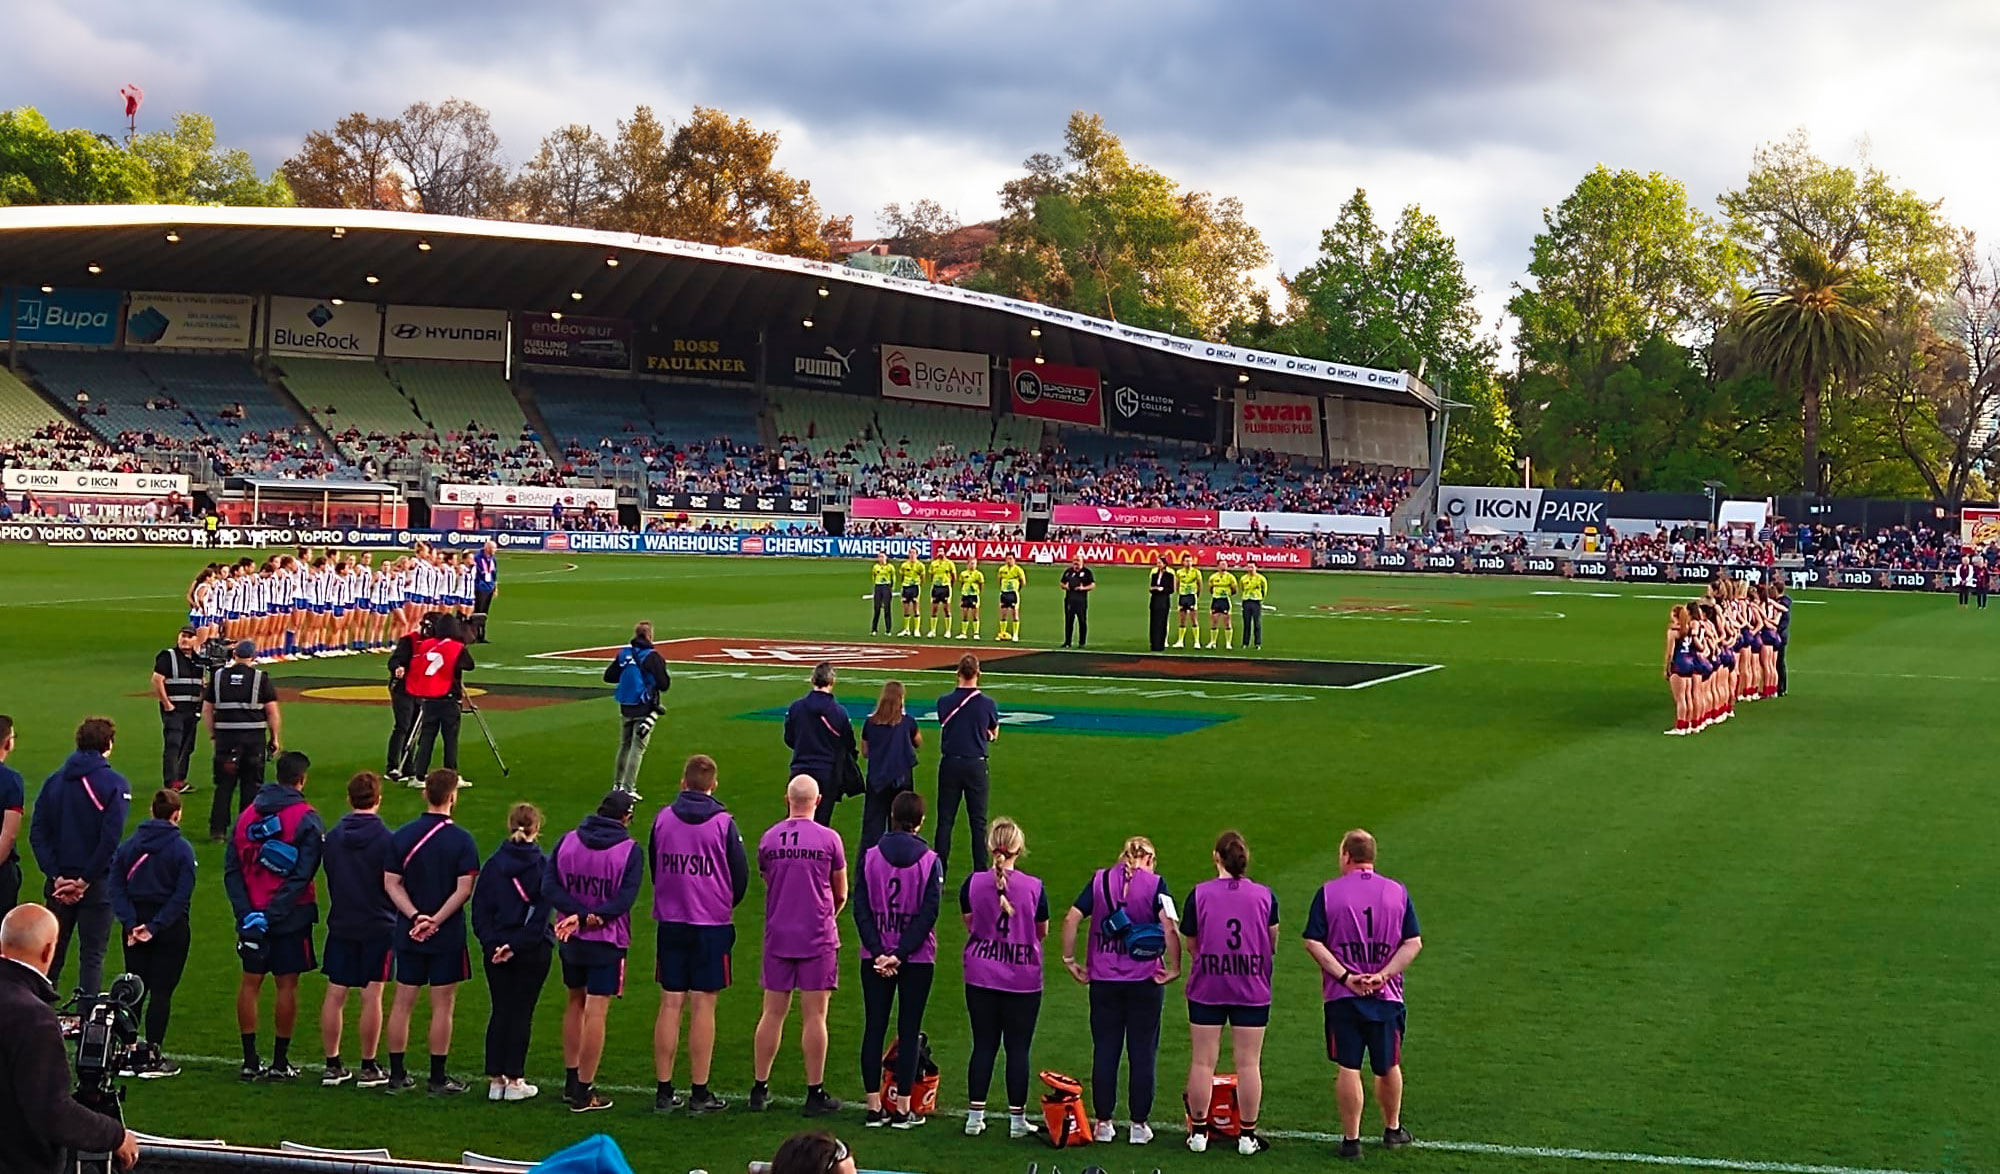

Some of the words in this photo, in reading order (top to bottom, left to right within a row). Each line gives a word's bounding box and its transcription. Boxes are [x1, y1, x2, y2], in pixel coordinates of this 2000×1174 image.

[45, 306, 108, 329] Bupa
[425, 326, 502, 341] HYUNDAI
[532, 321, 614, 337] endeavour
[274, 329, 359, 350] BlueRock
[524, 339, 568, 349] FUELLING
[673, 339, 720, 353] ROSS
[647, 356, 747, 371] FAULKNER
[794, 356, 841, 377] PUMA
[1216, 349, 1237, 359] IKON
[1257, 356, 1277, 366] IKON
[1297, 362, 1317, 373] IKON
[1337, 369, 1358, 379] IKON
[1378, 375, 1399, 386] IKON
[916, 381, 983, 395] STUDIOS
[1043, 384, 1086, 396] SPORTS
[1043, 392, 1086, 403] NUTRITION
[1141, 394, 1174, 404] CARLTON
[1141, 402, 1172, 413] COLLEGE
[1244, 404, 1313, 421] swan
[1245, 423, 1290, 434] PLUMBING
[1293, 424, 1313, 434] PLUS
[31, 475, 58, 485] IKON
[91, 477, 118, 487] IKON
[150, 479, 177, 489] IKON
[914, 508, 939, 519] virgin
[940, 508, 976, 518] australia
[1114, 513, 1139, 524] virgin
[1140, 514, 1176, 524] australia
[1475, 498, 1532, 519] IKON
[1541, 501, 1604, 523] PARK
[36, 526, 86, 541] YoPRO
[89, 527, 138, 541] YoPRO
[141, 527, 189, 542] YoPRO
[245, 529, 292, 543] YPRO
[295, 530, 343, 543] YoPRO
[360, 532, 392, 541] FURPHY
[410, 533, 442, 542] FURPHY
[460, 535, 491, 543] FURPHY
[510, 536, 541, 544] FURPHY
[570, 533, 640, 549] CHEMIST
[644, 536, 739, 552] WAREHOUSE
[765, 537, 834, 553] CHEMIST
[838, 539, 931, 556] WAREHOUSE
[982, 543, 1022, 558] AAMI
[1028, 545, 1067, 559] AAMI
[1076, 546, 1113, 559] AAMI
[1216, 551, 1243, 562] footy.
[1262, 552, 1288, 562] lovin'
[1331, 553, 1357, 564] nab
[1380, 554, 1406, 565] nab
[1429, 556, 1455, 567] nab
[1479, 557, 1505, 569] nab
[1529, 559, 1555, 570] nab
[1580, 563, 1606, 575] nab
[1631, 564, 1658, 576] nab
[1683, 566, 1709, 578] nab
[1845, 571, 1871, 583] nab
[1898, 573, 1925, 586] nab
[779, 831, 799, 846] 11
[764, 848, 825, 861] ELBOURNE
[661, 852, 714, 877] PHYSIO
[888, 877, 902, 908] 2
[996, 910, 1010, 938] 4
[1363, 906, 1374, 938] 1
[1226, 918, 1242, 950] 3
[970, 939, 1032, 966] TRAINER
[1199, 953, 1265, 976] TRAINER
